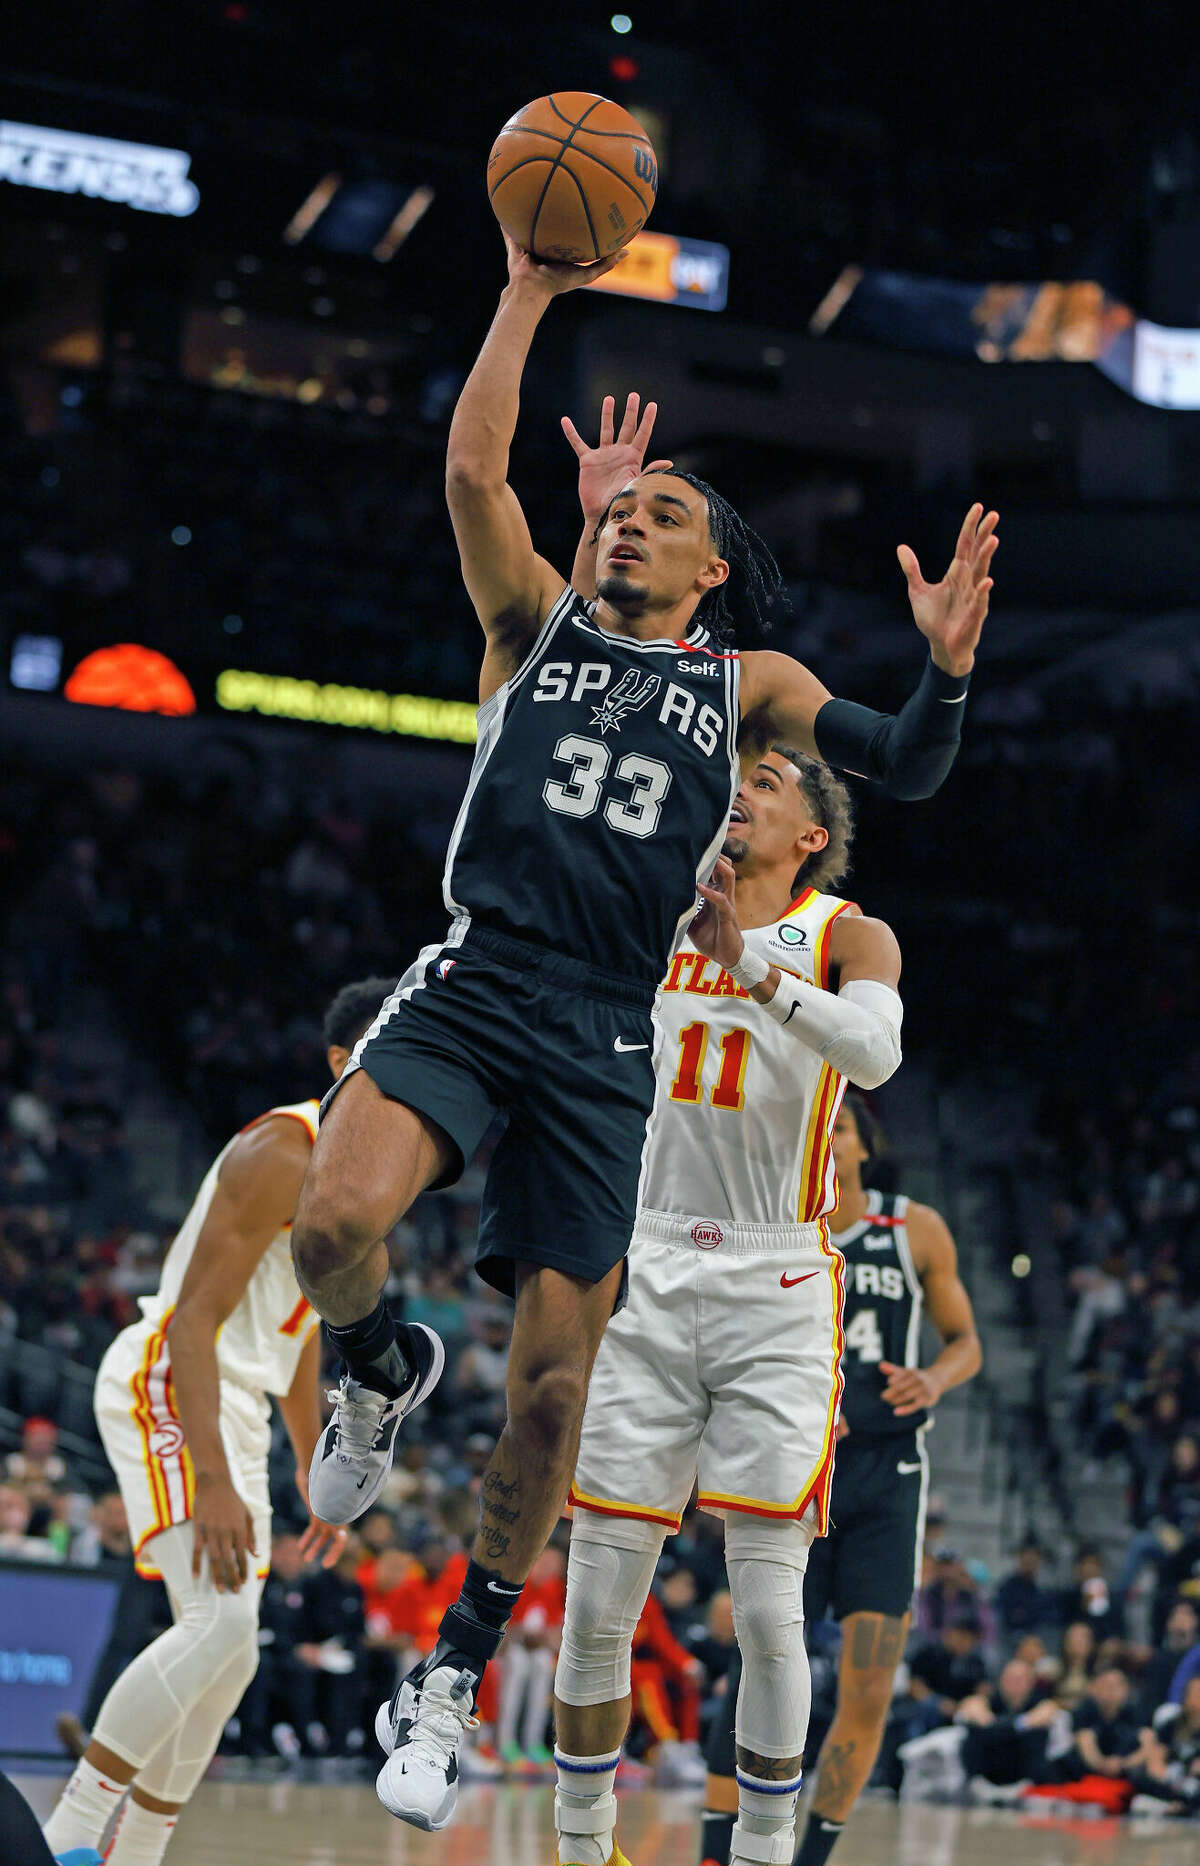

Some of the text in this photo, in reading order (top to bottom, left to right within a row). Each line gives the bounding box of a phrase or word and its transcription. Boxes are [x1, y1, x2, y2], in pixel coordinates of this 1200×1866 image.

[677, 660, 720, 677] Self.
[532, 662, 724, 758] SPURS
[542, 733, 673, 839] 33
[669, 1020, 751, 1113] 11
[690, 1229, 724, 1242] HAWKS
[844, 1308, 883, 1363] 4
